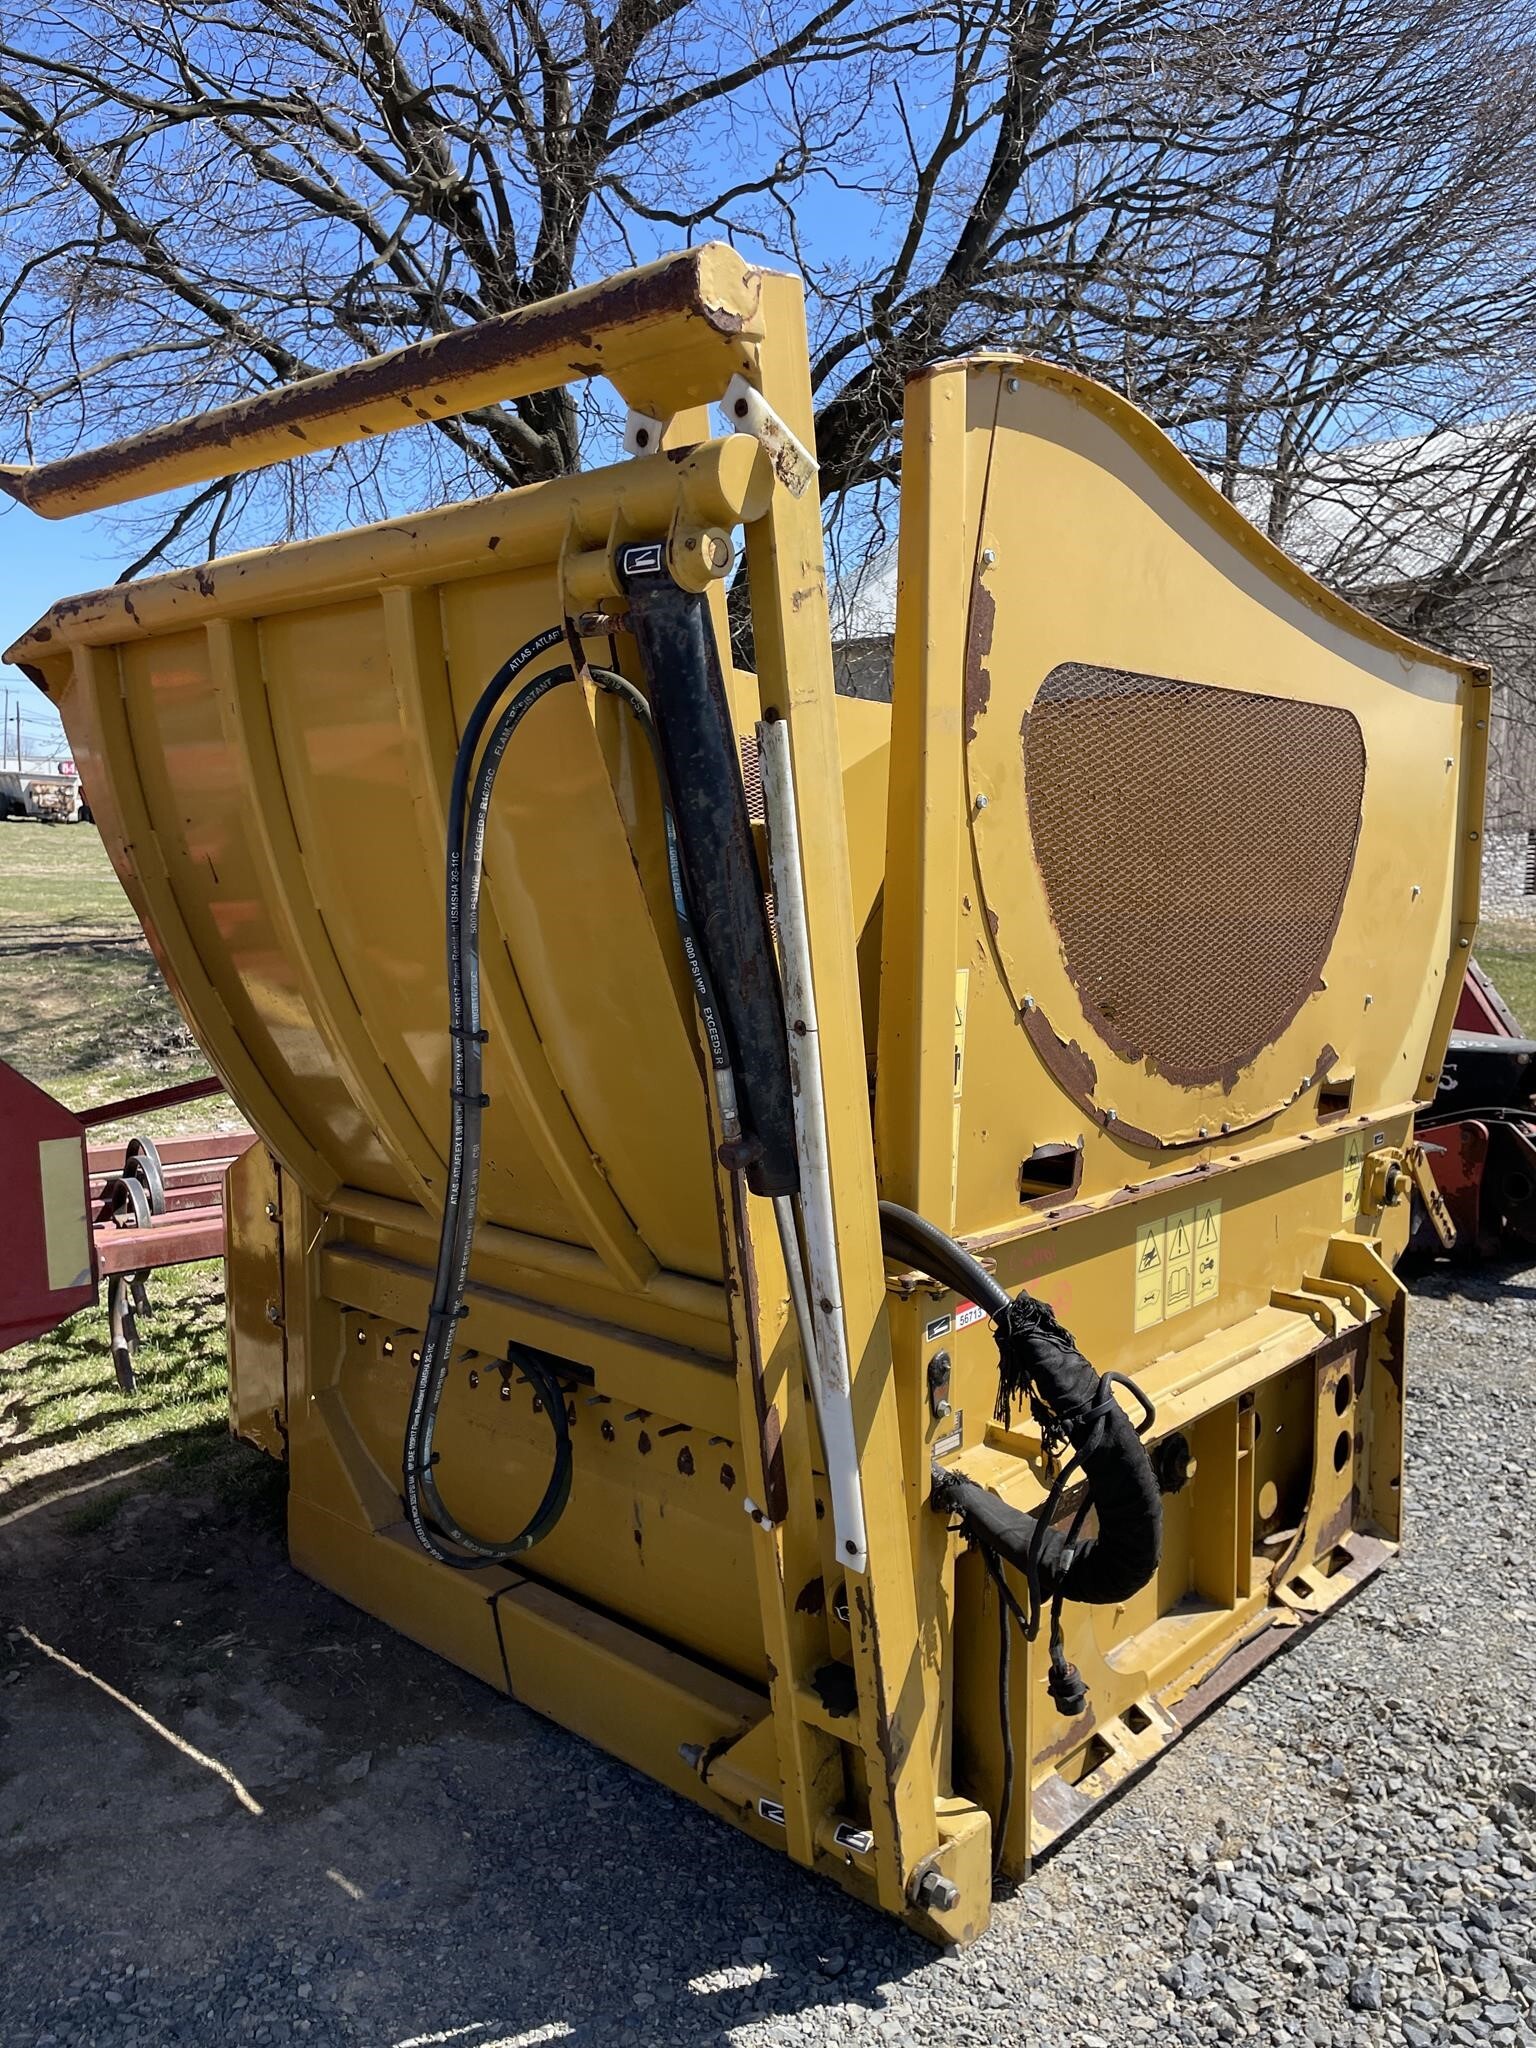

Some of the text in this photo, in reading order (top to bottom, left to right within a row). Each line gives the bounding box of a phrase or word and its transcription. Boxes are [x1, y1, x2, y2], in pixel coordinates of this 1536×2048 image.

[509, 648, 532, 671] ATLAS
[470, 911, 478, 934] 5000
[474, 813, 485, 861] EXCEEDS
[480, 768, 495, 810] R16/2SC
[451, 852, 459, 882] 2G-11C
[450, 884, 459, 922] USMSHA
[684, 936, 696, 960] 5000
[691, 960, 700, 978] PSI
[697, 977, 706, 995] WP
[703, 1007, 722, 1057] EXCEEDS
[450, 1183, 460, 1204] ATLAS
[959, 1308, 982, 1326] 56713
